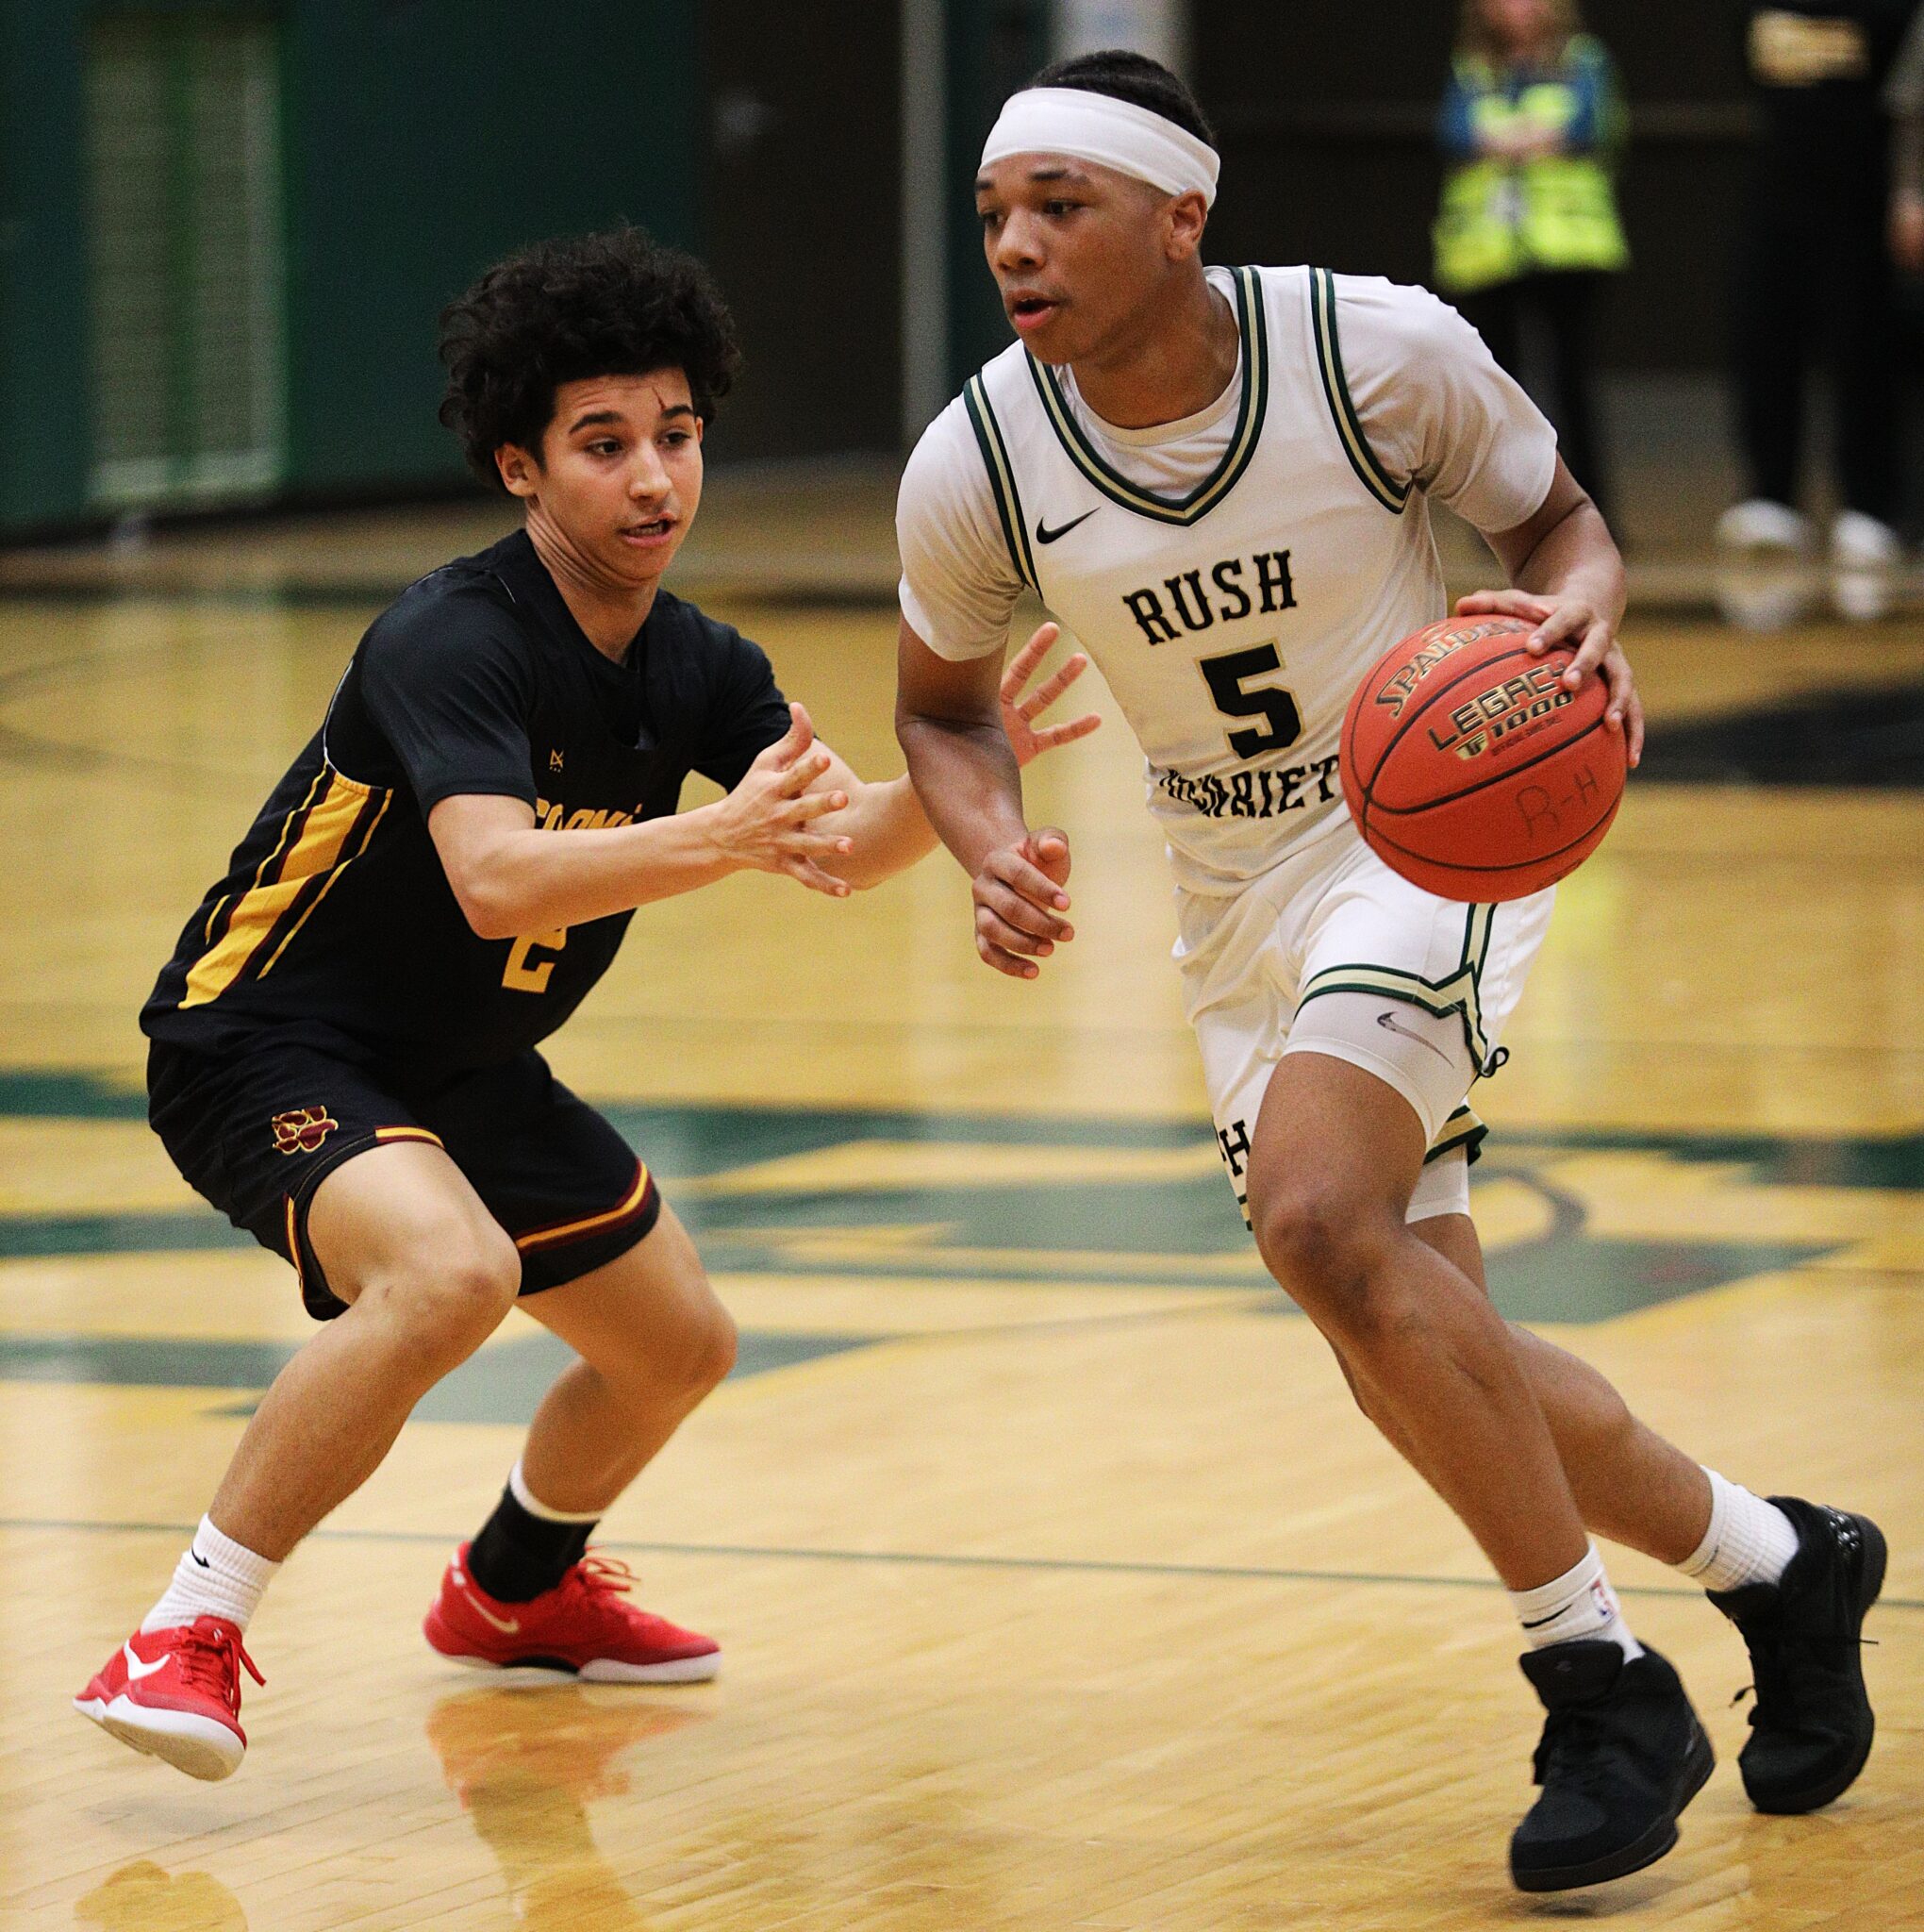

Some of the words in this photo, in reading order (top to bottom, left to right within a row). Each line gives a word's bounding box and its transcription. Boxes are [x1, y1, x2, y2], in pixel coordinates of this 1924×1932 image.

[1121, 549, 1297, 646] RUSH
[1194, 637, 1307, 760] 5
[1489, 689, 1575, 740] 1000
